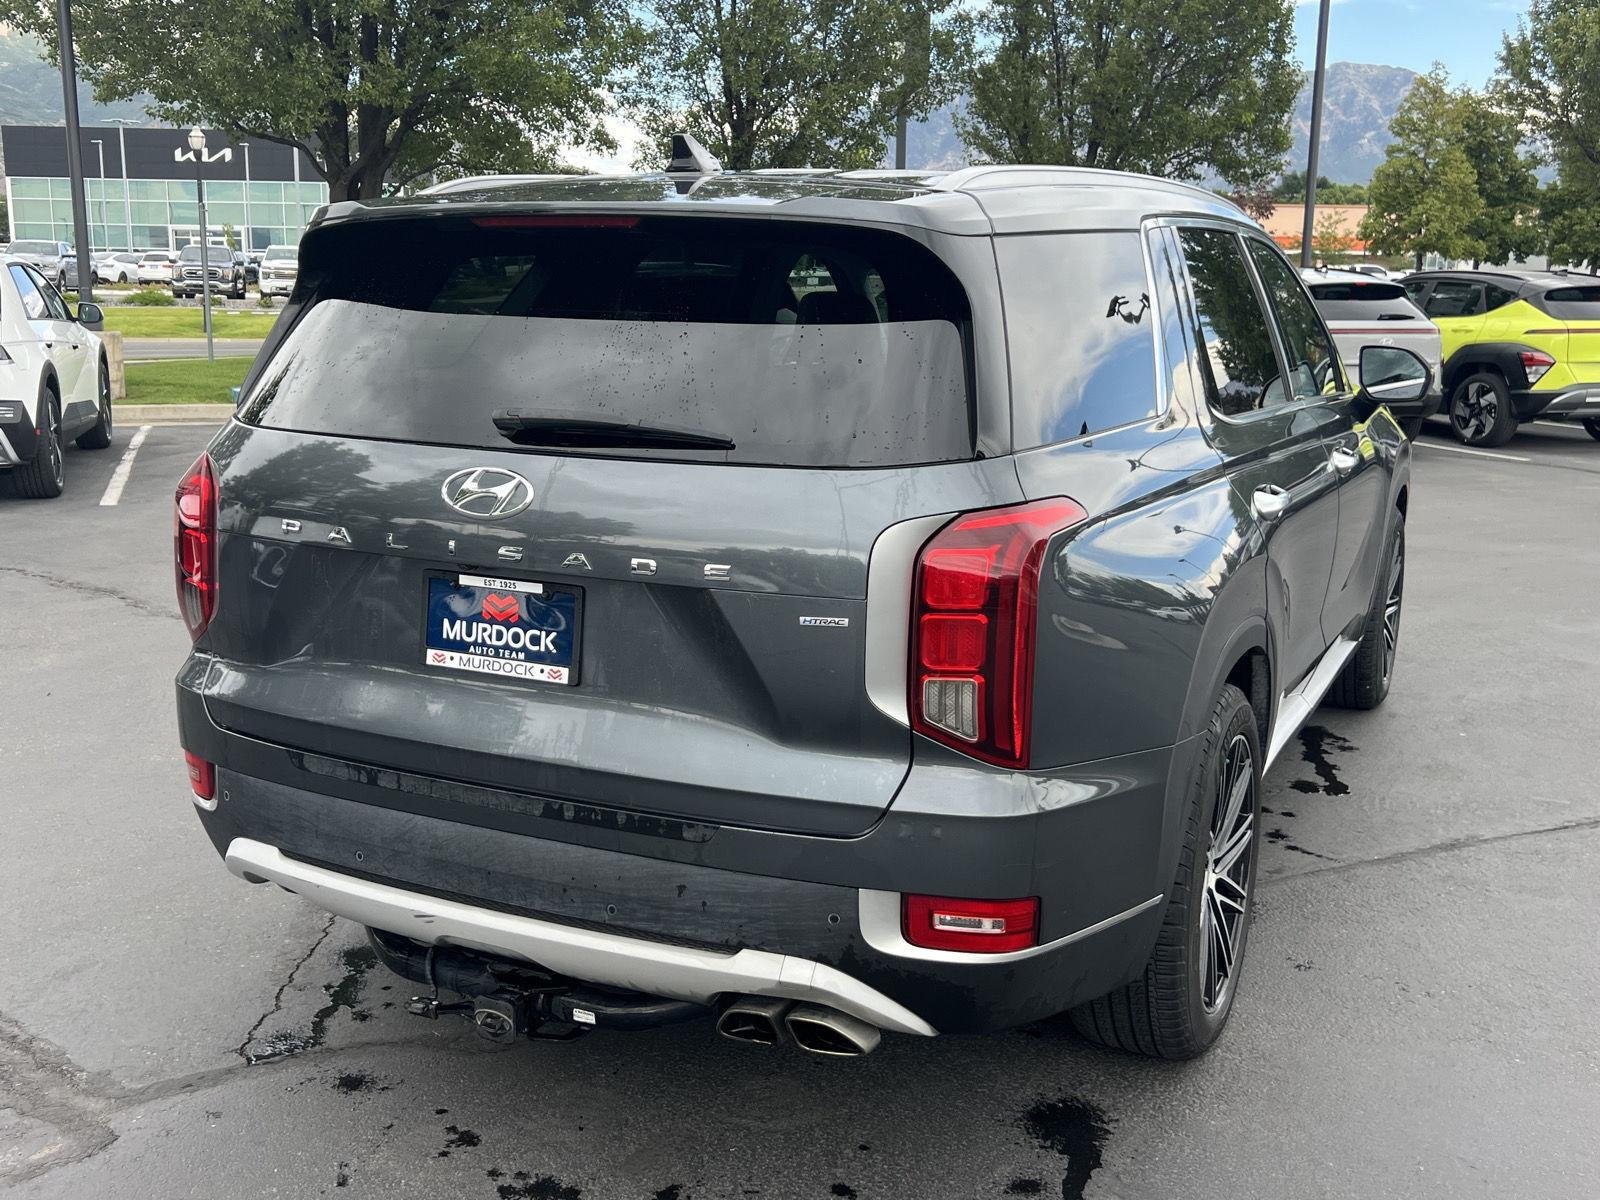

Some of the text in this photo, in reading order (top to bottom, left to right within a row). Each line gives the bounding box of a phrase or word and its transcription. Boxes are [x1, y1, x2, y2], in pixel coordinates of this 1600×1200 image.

[174, 146, 232, 162] KIA
[281, 517, 732, 582] PALISADE
[499, 580, 517, 589] 1925
[802, 618, 846, 626] HTRAC
[442, 617, 558, 653] MURDOCK
[468, 645, 525, 660] AUTO TEAM
[458, 655, 535, 677] MURDOCK
